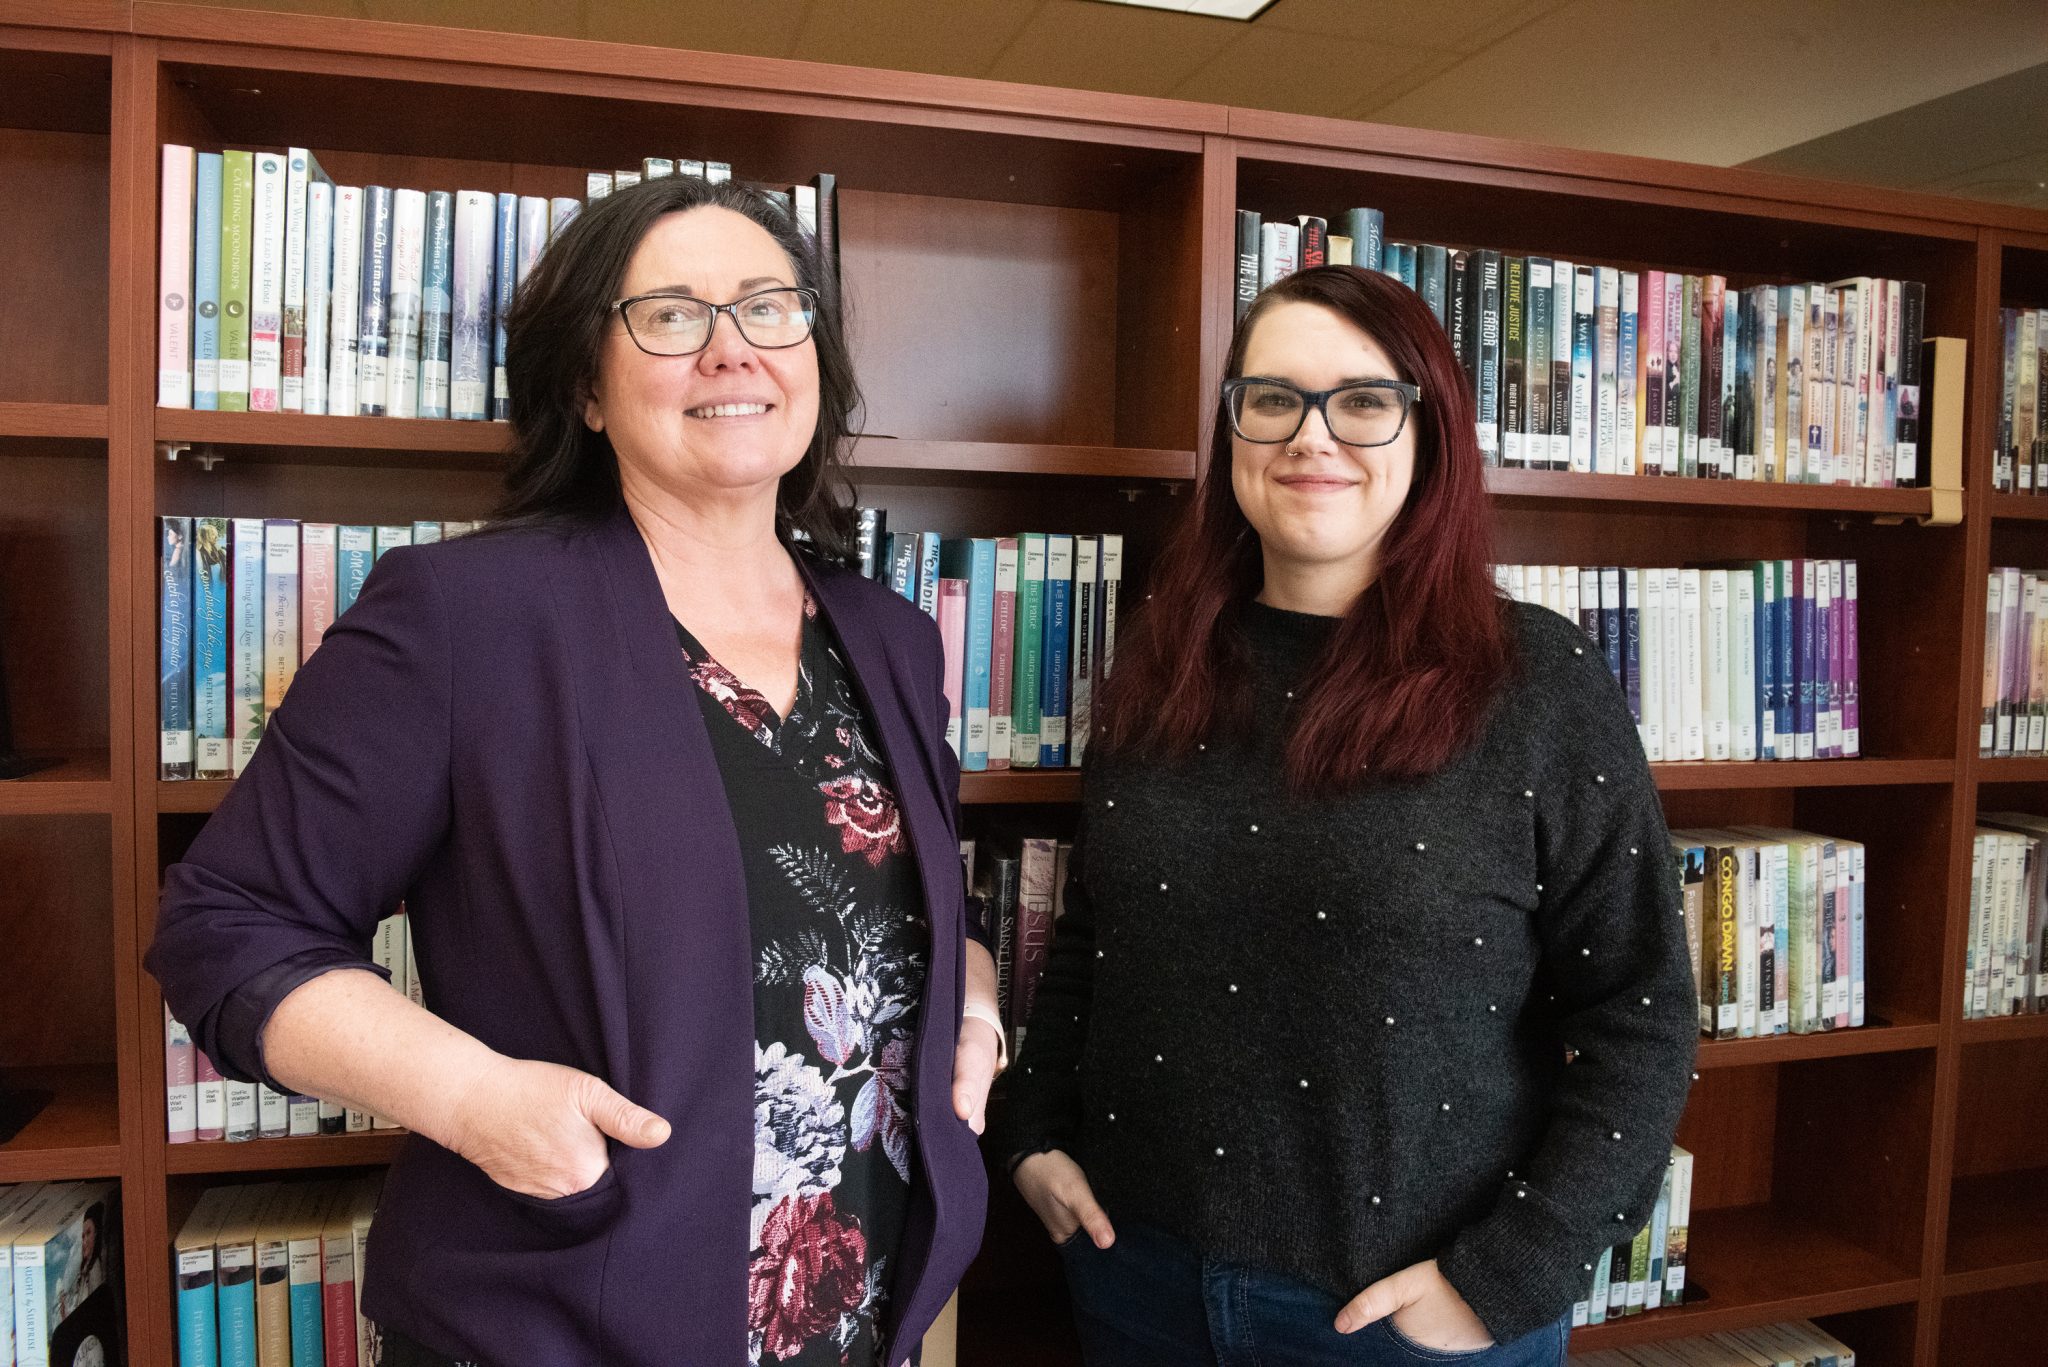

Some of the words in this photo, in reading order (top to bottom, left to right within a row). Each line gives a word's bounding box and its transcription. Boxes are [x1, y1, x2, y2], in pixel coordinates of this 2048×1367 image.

[233, 168, 243, 221] CATCHING
[266, 182, 275, 208] GRACE
[293, 180, 303, 195] On
[265, 212, 274, 233] WILL
[291, 208, 303, 232] Wing
[375, 205, 389, 228] The
[264, 237, 273, 259] LEAD
[292, 237, 301, 256] and
[433, 217, 446, 270] Christmas
[1279, 229, 1289, 251] THE
[1309, 227, 1320, 248] THE
[1369, 223, 1381, 271] Mountai
[231, 224, 241, 289] MOONDROPS
[341, 228, 353, 277] Christmas
[374, 232, 388, 292] Christmas
[504, 229, 515, 278] Christmas
[1240, 253, 1259, 275] THE
[264, 262, 273, 277] ME
[1484, 261, 1498, 291] TRIAL
[1509, 262, 1521, 303] RELATIVE
[264, 279, 272, 305] HOME
[289, 267, 301, 300] Prayer
[1240, 278, 1259, 302] LIST
[1430, 277, 1439, 297] the
[1560, 283, 1568, 327] ROMISED
[1652, 279, 1664, 348] WHITSON
[1483, 310, 1498, 346] ERROR
[1509, 304, 1521, 342] JUSTICE
[169, 323, 179, 359] VALENT
[204, 330, 214, 359] VALEN
[229, 329, 240, 360] VALEN
[1536, 327, 1545, 369] PEOPLE
[1560, 329, 1568, 358] LAND
[1863, 334, 1869, 344] TO
[1624, 344, 1633, 376] LOVE
[1484, 360, 1494, 392] ROBERT
[1509, 383, 1518, 408] ROBERT
[1575, 384, 1583, 421] WHIT
[1652, 386, 1661, 425] Jacob's
[1483, 394, 1493, 424] WHITLO
[1509, 409, 1517, 433] WHITLO
[1601, 389, 1609, 447] WHITLO
[307, 543, 330, 579] Things
[905, 543, 913, 562] THE
[932, 544, 940, 561] THE
[245, 556, 255, 577] Little
[349, 550, 364, 600] oments
[977, 549, 990, 585] miss
[166, 570, 182, 599] catch
[197, 569, 223, 622] somebody
[243, 578, 254, 602] Thing
[278, 575, 287, 592] Like
[312, 584, 329, 595] I
[924, 559, 935, 613] CANDID
[245, 603, 254, 628] Called
[275, 594, 287, 617] Being
[309, 599, 326, 635] Never
[163, 609, 188, 646] falling
[278, 619, 287, 627] in
[976, 592, 990, 659] invisible
[1609, 616, 1618, 633] The
[1629, 613, 1638, 632] The
[206, 623, 223, 649] like
[241, 629, 254, 648] Love
[273, 629, 287, 648] Love
[1628, 630, 1638, 662] Pursuit
[171, 647, 181, 672] star
[203, 648, 214, 670] you
[171, 682, 179, 703] BETH
[206, 677, 214, 696] BETH
[171, 704, 179, 712] K.
[206, 698, 214, 706] K.
[206, 706, 214, 730] VOGT
[1764, 859, 1772, 880] Along
[1986, 858, 1995, 895] WHISPERS
[1722, 855, 1734, 919] CONGO
[1985, 896, 1994, 904] IN
[1984, 907, 1993, 920] THE
[1001, 916, 1015, 958] SAINT
[1022, 891, 1050, 963] JESUS
[1982, 923, 1992, 948] VALLEY
[1722, 921, 1734, 971] DAWN
[998, 959, 1013, 1009] JULIAN
[1765, 958, 1773, 1011] WINDSOR
[177, 1055, 188, 1085] WALL
[25, 1266, 34, 1297] AUGHT
[235, 1307, 243, 1317] IT
[271, 1296, 280, 1327] WHEN
[303, 1296, 313, 1317] THE
[337, 1310, 345, 1327] THE
[27, 1308, 37, 1351] SURPRISE
[194, 1322, 202, 1347] HAD
[234, 1320, 243, 1343] HAD
[304, 1319, 314, 1362] WONDER
[338, 1328, 347, 1348] ONE
[195, 1348, 203, 1362] TO
[236, 1346, 243, 1358] TO
